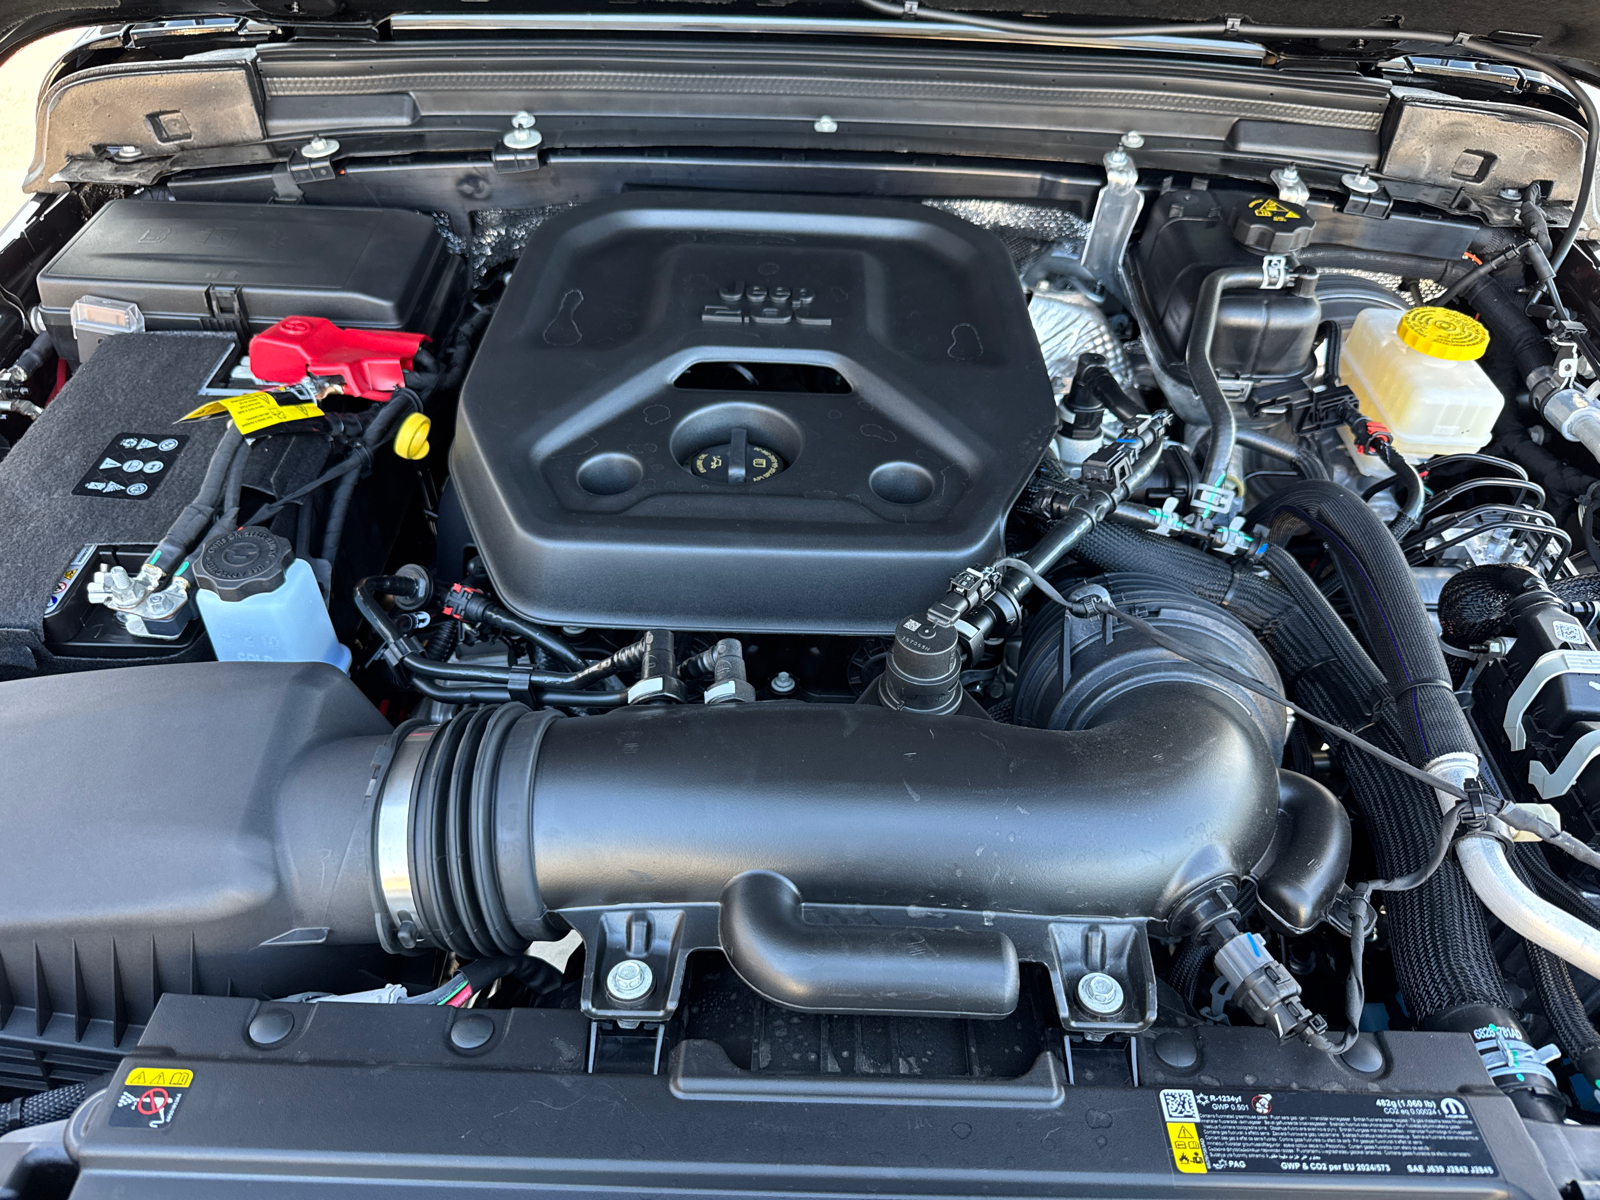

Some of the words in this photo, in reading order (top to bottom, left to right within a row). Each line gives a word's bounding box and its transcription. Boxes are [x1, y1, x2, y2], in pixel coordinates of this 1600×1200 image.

[719, 281, 815, 307] Jeep
[1473, 1026, 1523, 1040] 6828781AD
[1211, 1103, 1229, 1111] GWP
[1228, 1160, 1246, 1169] PAG
[1280, 1161, 1301, 1171] GWP
